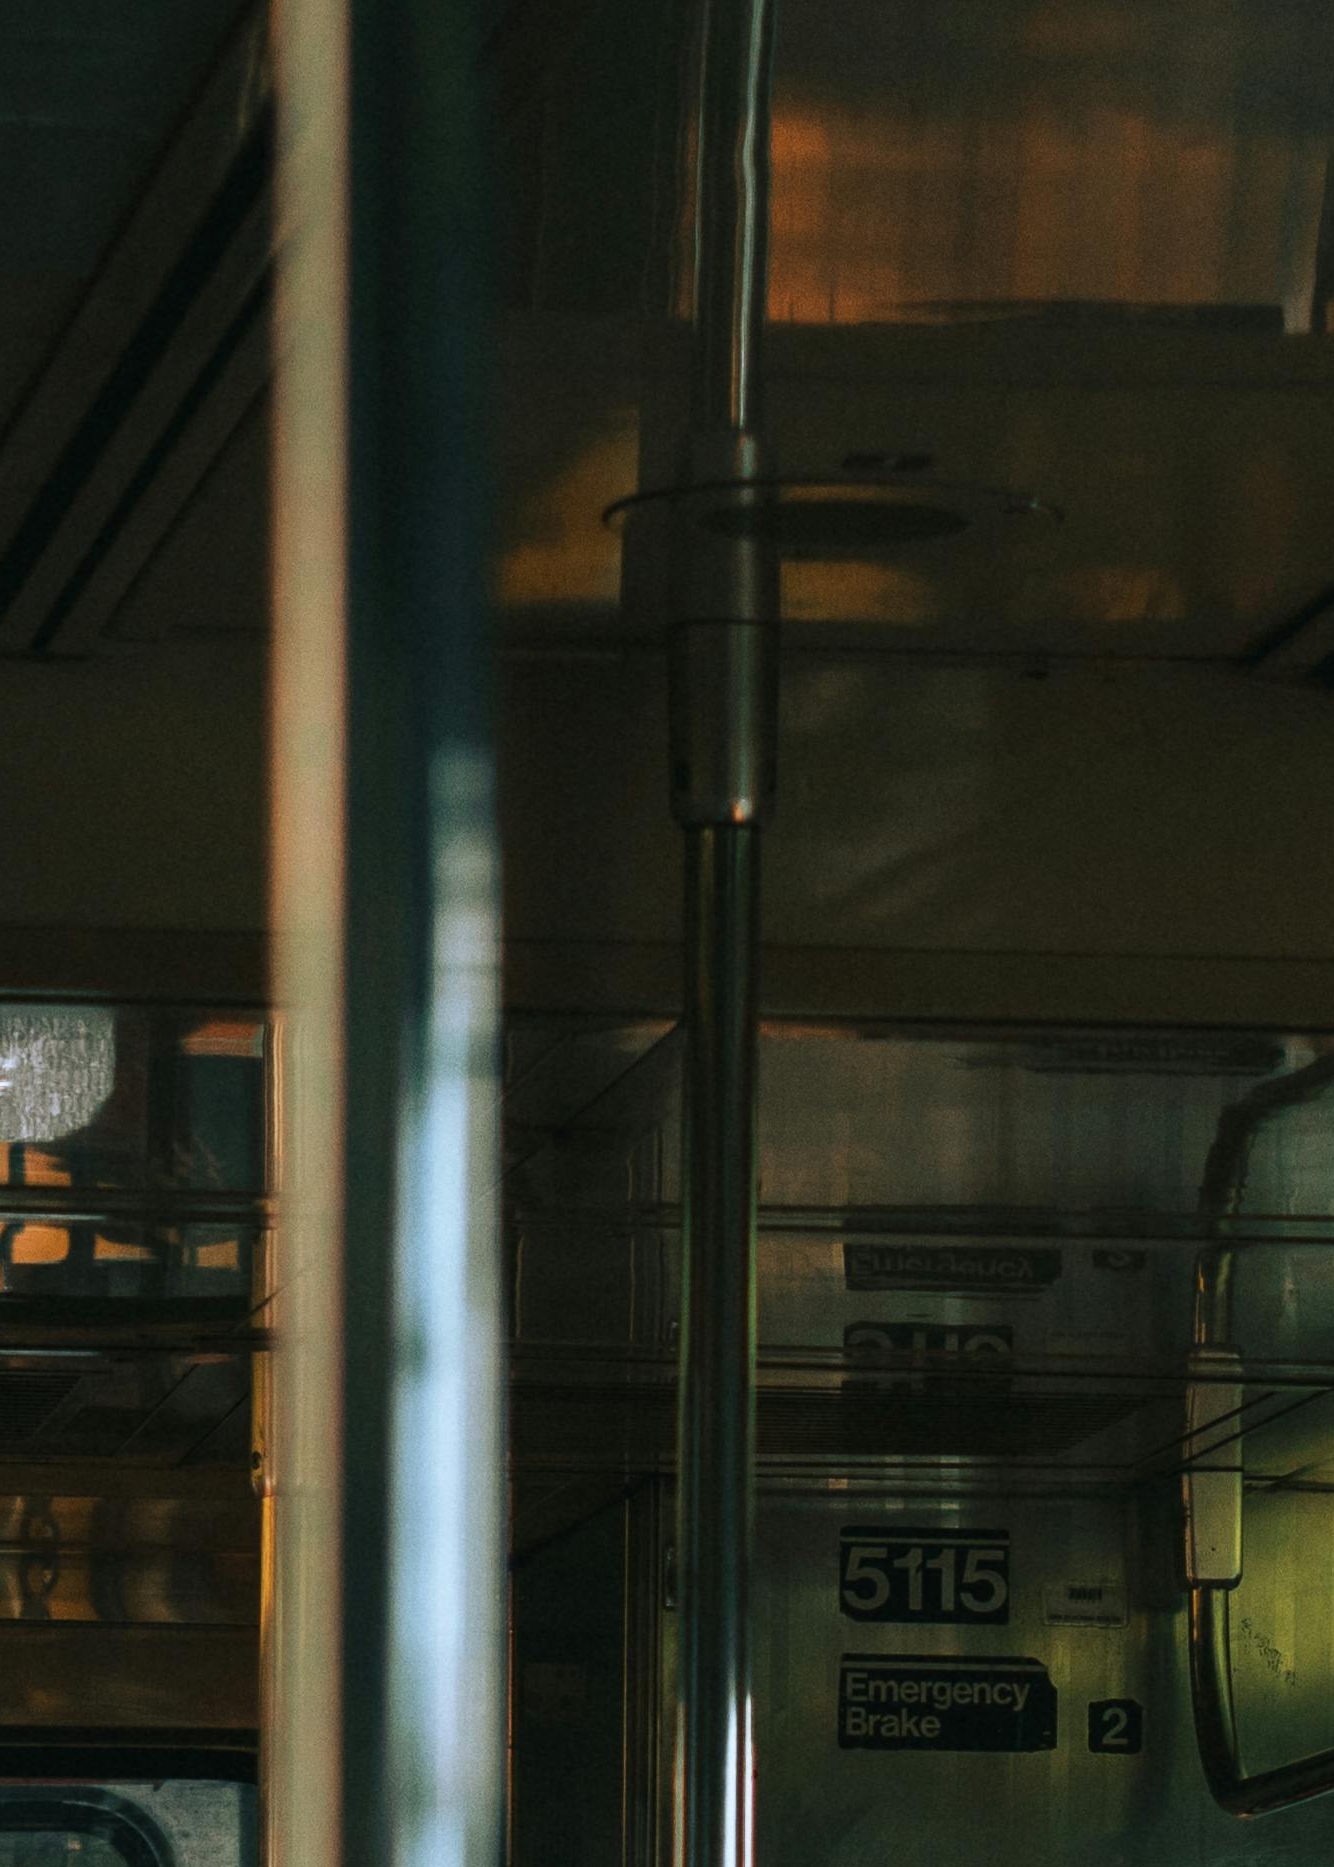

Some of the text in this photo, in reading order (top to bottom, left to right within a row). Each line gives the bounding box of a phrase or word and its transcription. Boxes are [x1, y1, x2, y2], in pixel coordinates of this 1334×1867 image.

[842, 1546, 1008, 1613] 5115
[845, 1672, 1031, 1712] Emergency
[845, 1707, 941, 1738] Brake
[1100, 1707, 1129, 1746] 2
